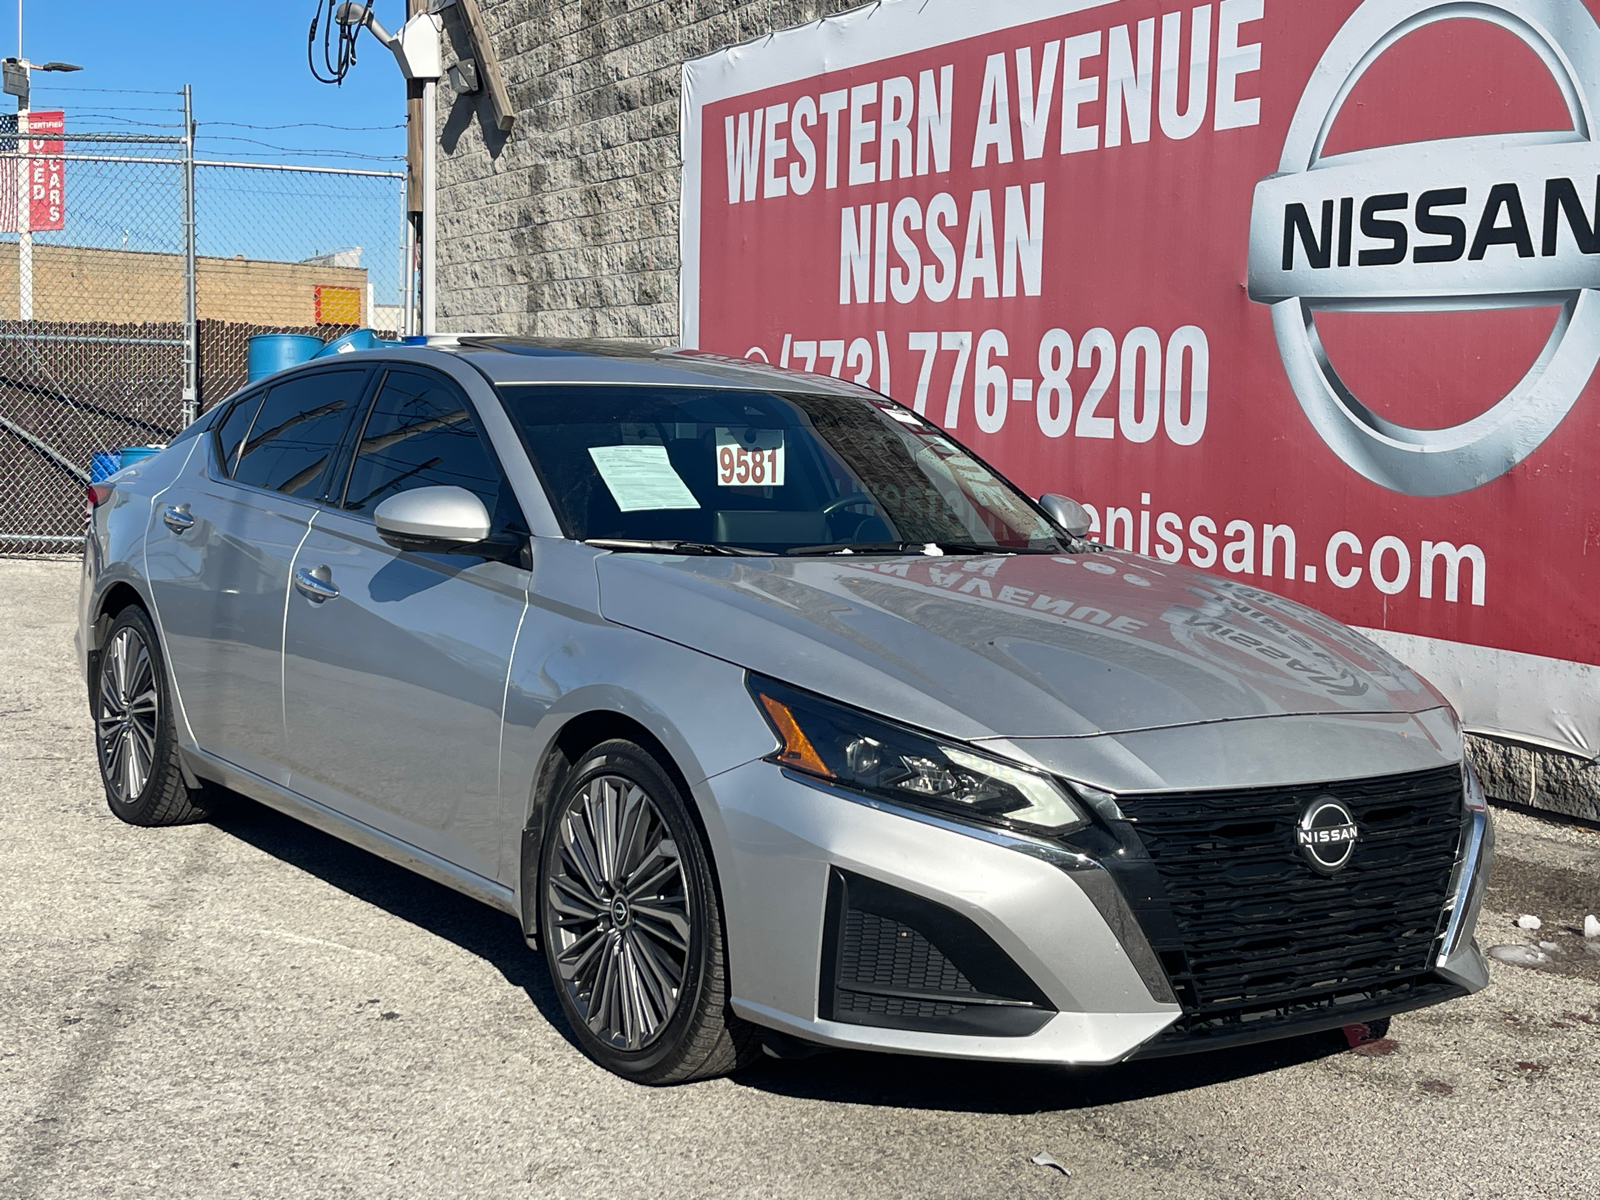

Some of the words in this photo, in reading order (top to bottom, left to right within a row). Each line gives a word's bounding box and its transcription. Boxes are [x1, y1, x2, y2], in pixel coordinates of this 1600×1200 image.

[29, 121, 63, 129] CERTIFIED
[725, 65, 953, 205] WESTERN
[971, 0, 1264, 169] AVENUE
[49, 159, 60, 222] CARS
[1282, 174, 1600, 270] NISSAN
[840, 182, 1045, 304] NISSAN
[908, 325, 1209, 445] 776-8200
[720, 447, 776, 484] 9581
[1300, 826, 1357, 843] NISSAN
